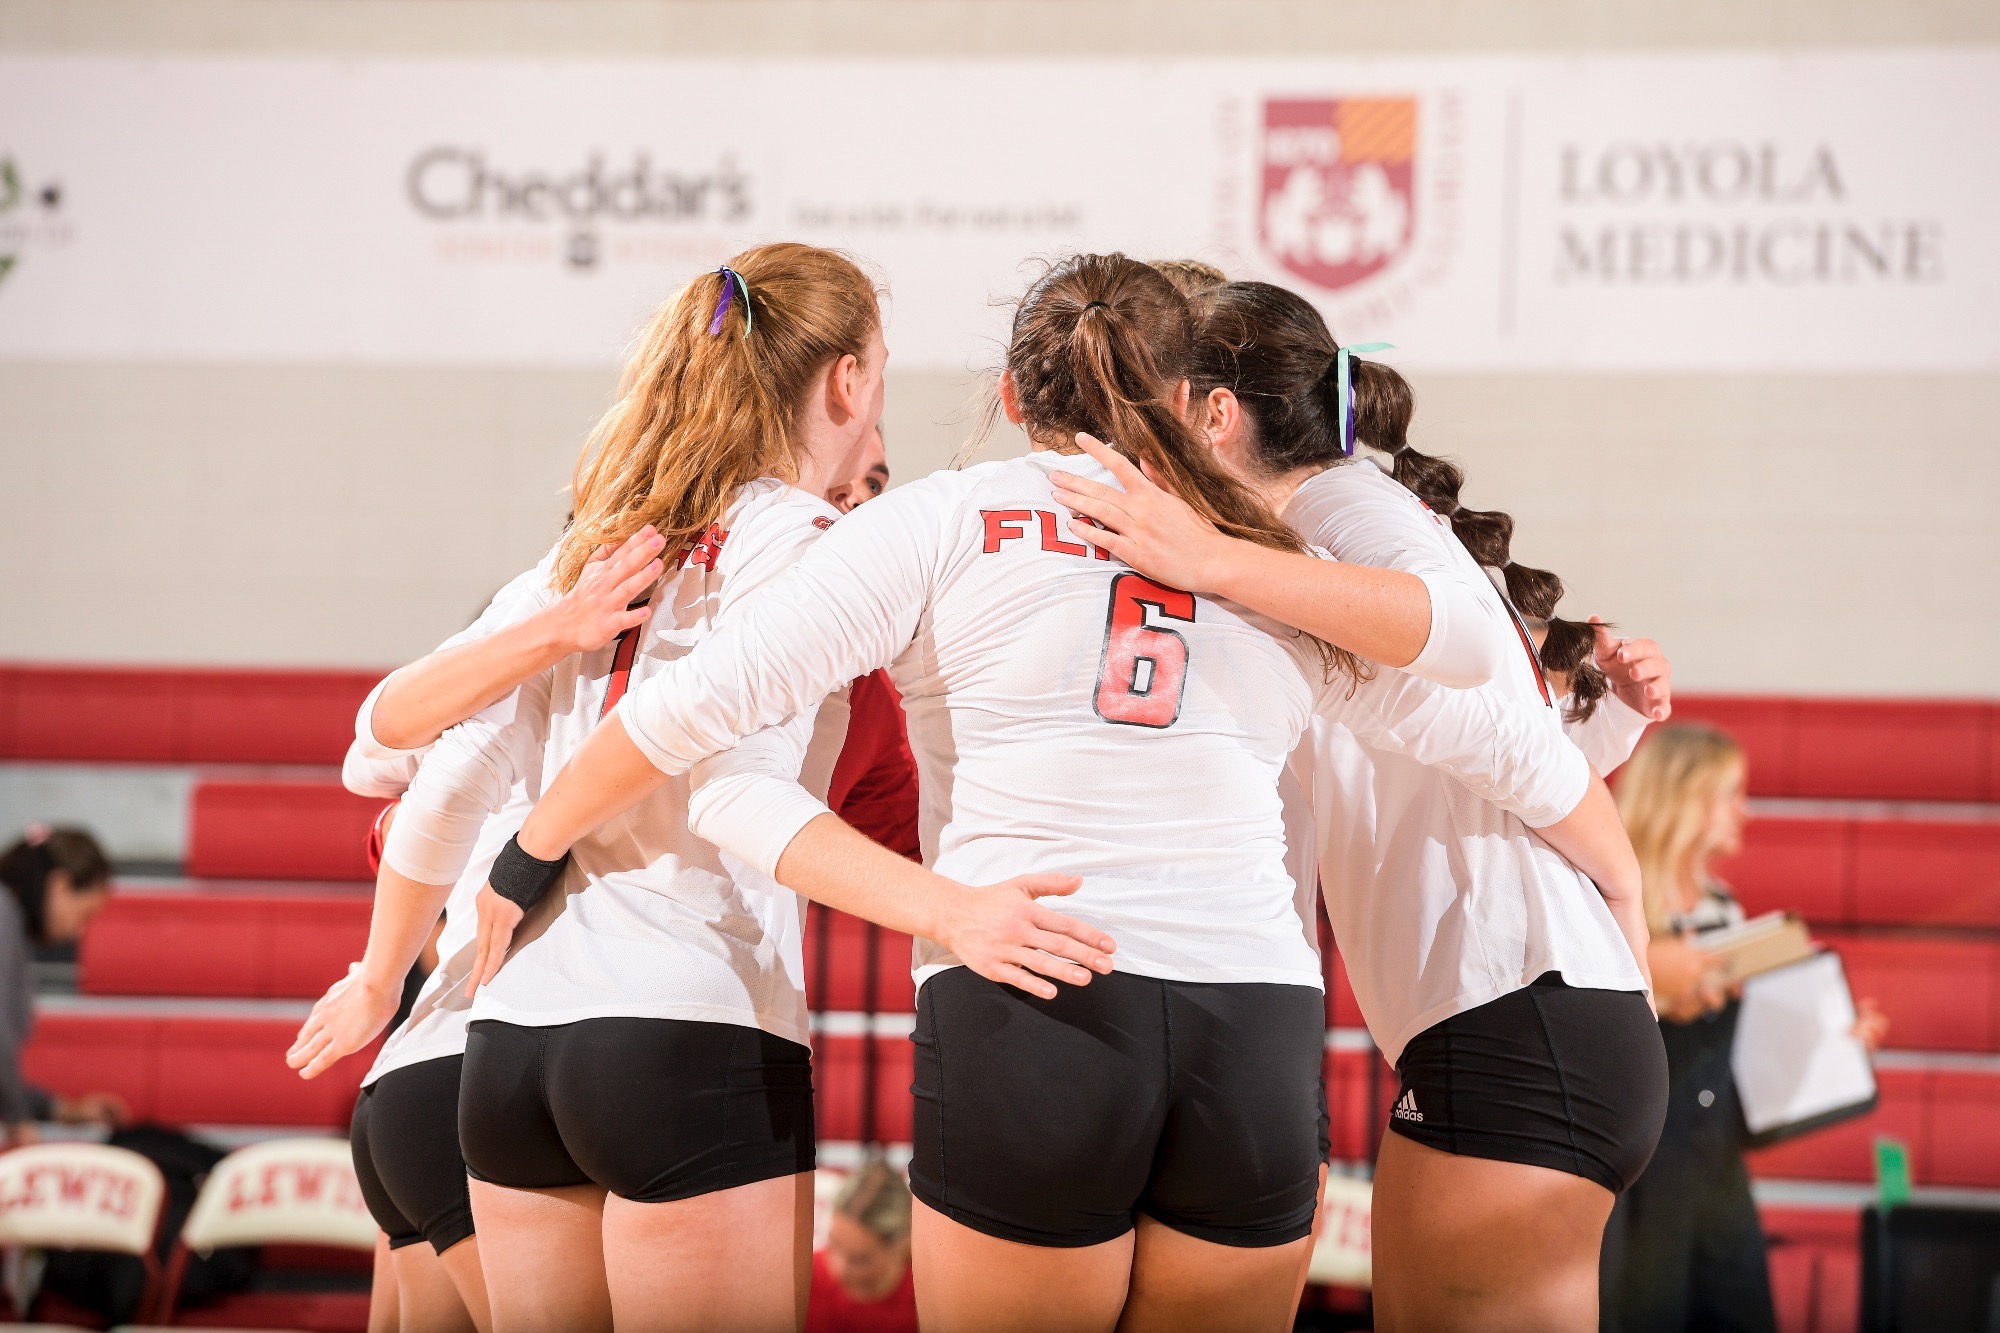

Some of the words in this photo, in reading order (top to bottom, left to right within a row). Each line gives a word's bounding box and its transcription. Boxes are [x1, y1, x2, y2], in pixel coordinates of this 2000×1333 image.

[405, 145, 753, 221] Cheddar's
[1558, 140, 1846, 202] LOYOLA
[1554, 216, 1945, 284] MEDICINE
[1092, 570, 1196, 729] 6
